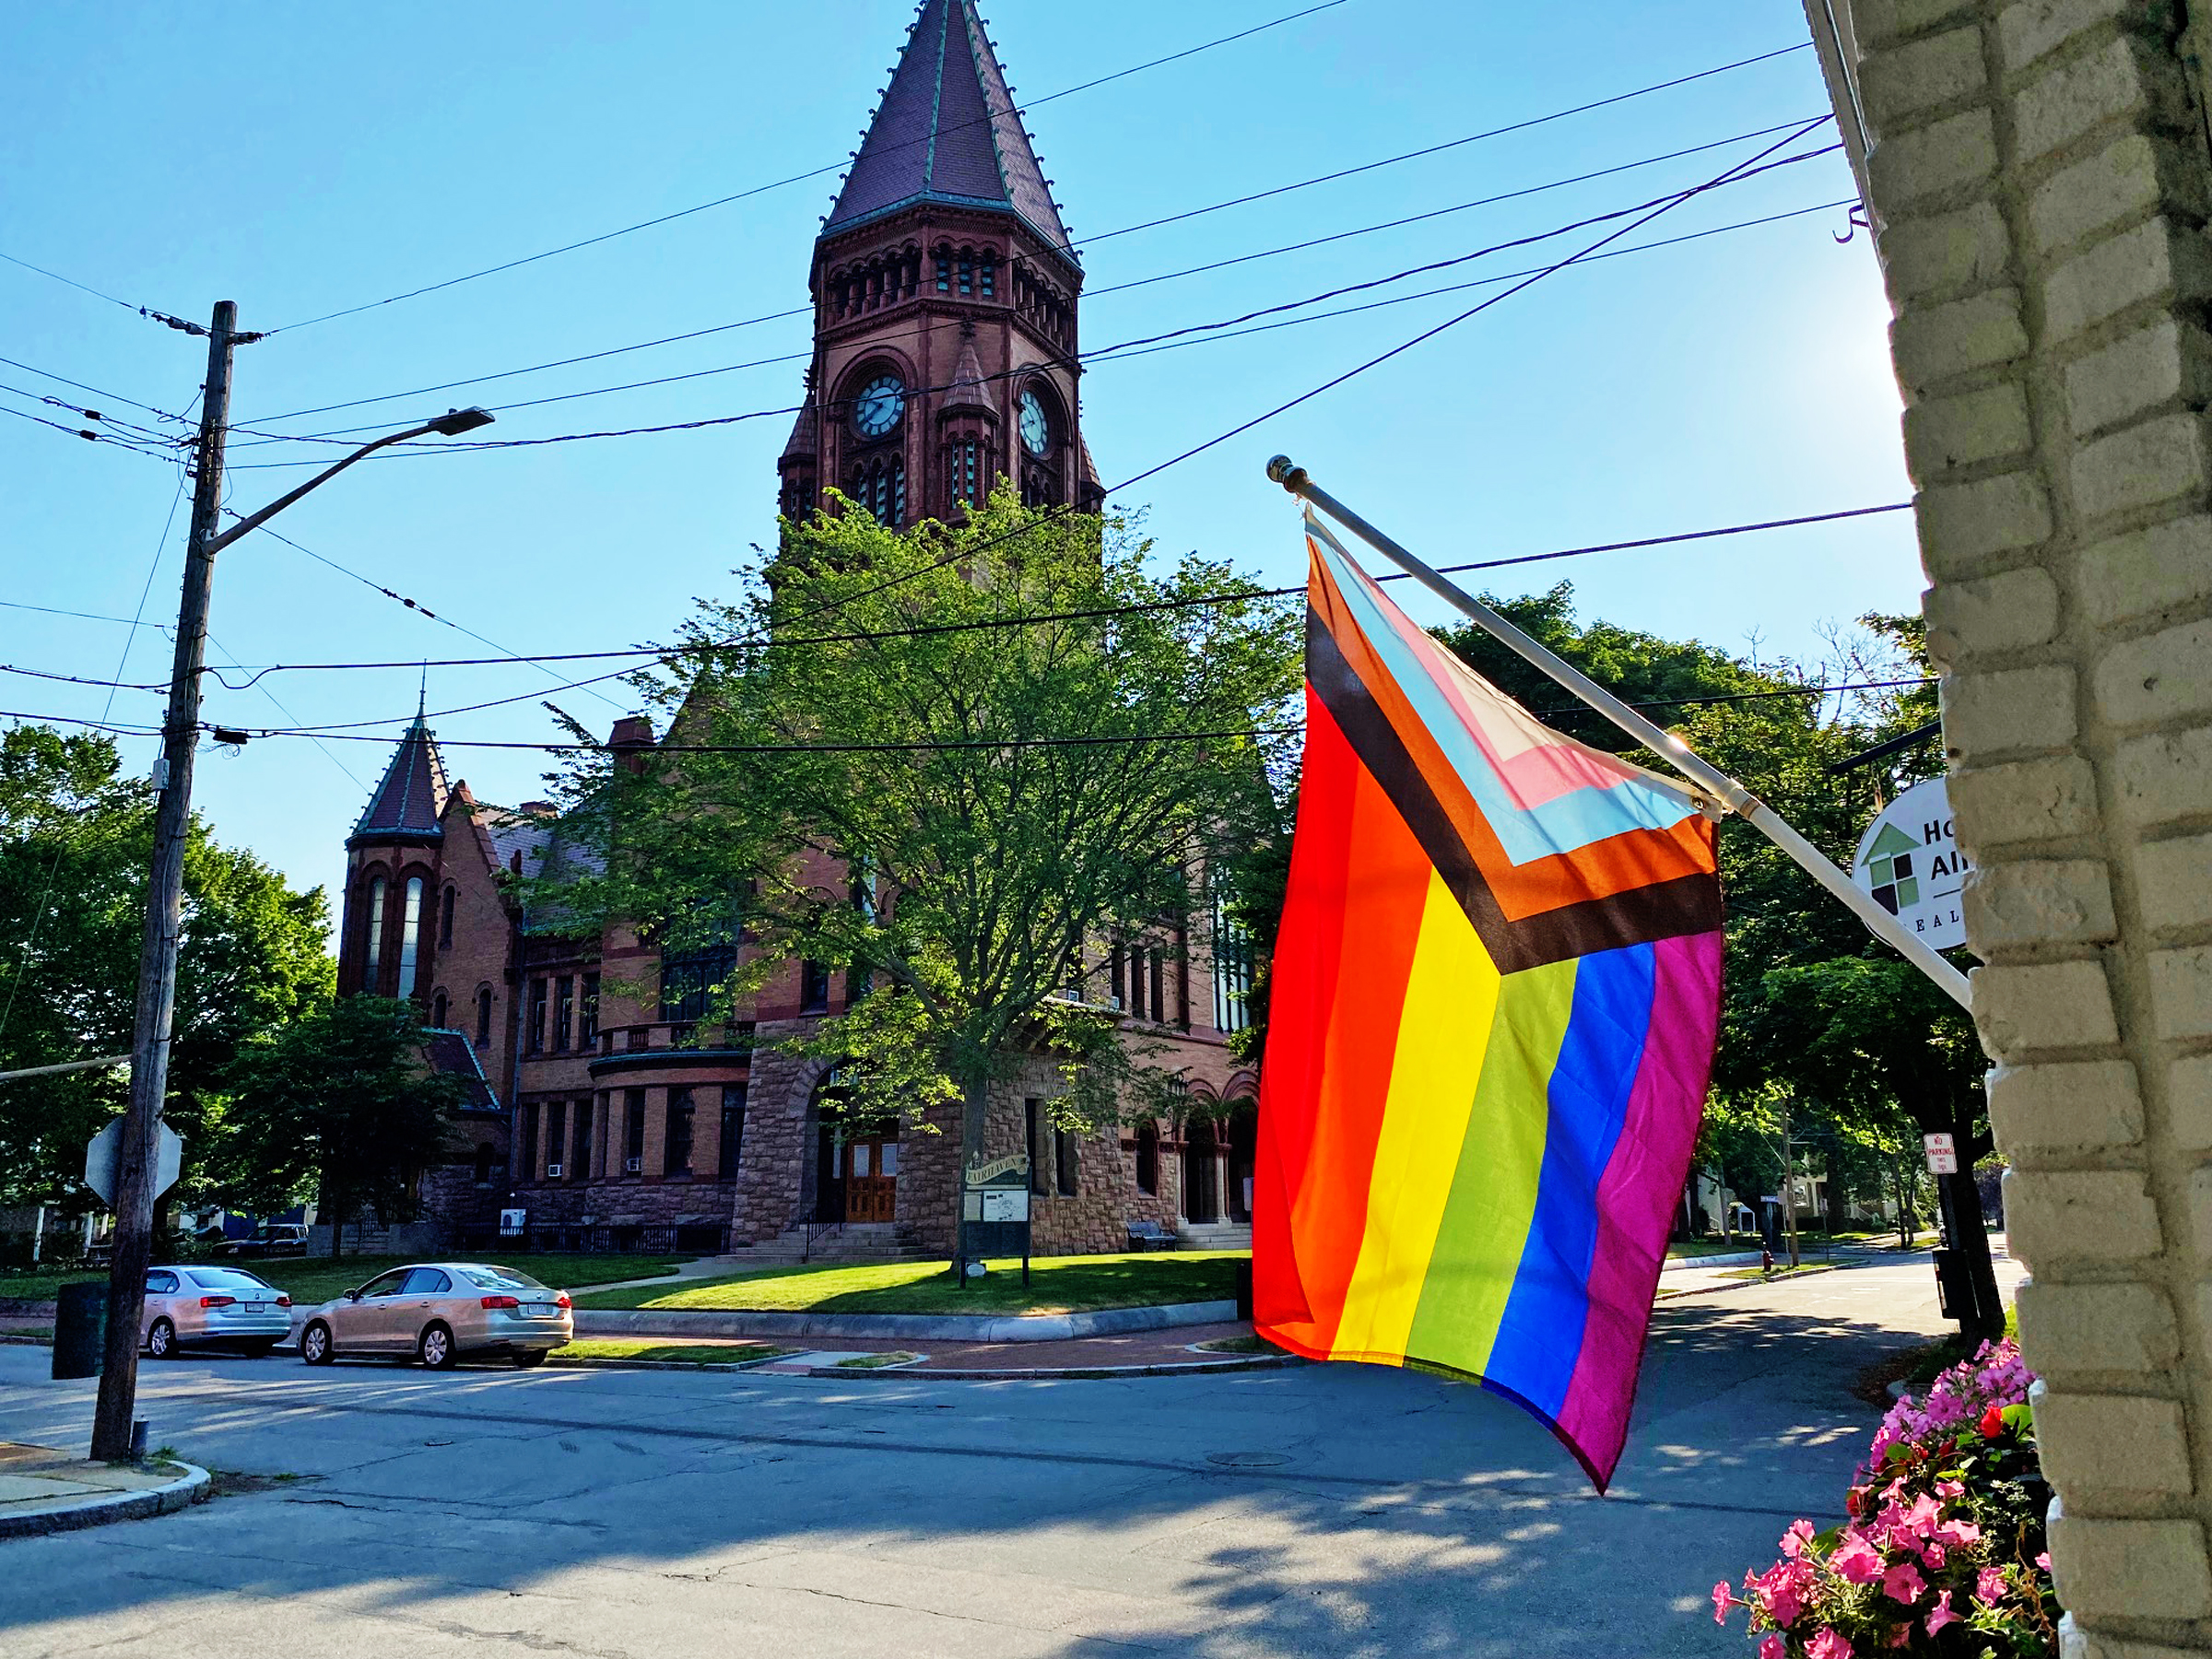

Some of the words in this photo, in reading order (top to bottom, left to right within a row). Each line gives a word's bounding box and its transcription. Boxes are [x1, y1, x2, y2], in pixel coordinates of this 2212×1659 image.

[1904, 911, 1959, 932] EAL
[1934, 1135, 1943, 1145] NO
[1928, 1147, 1953, 1156] PARKING
[966, 1158, 1018, 1182] FAIRHAVEN
